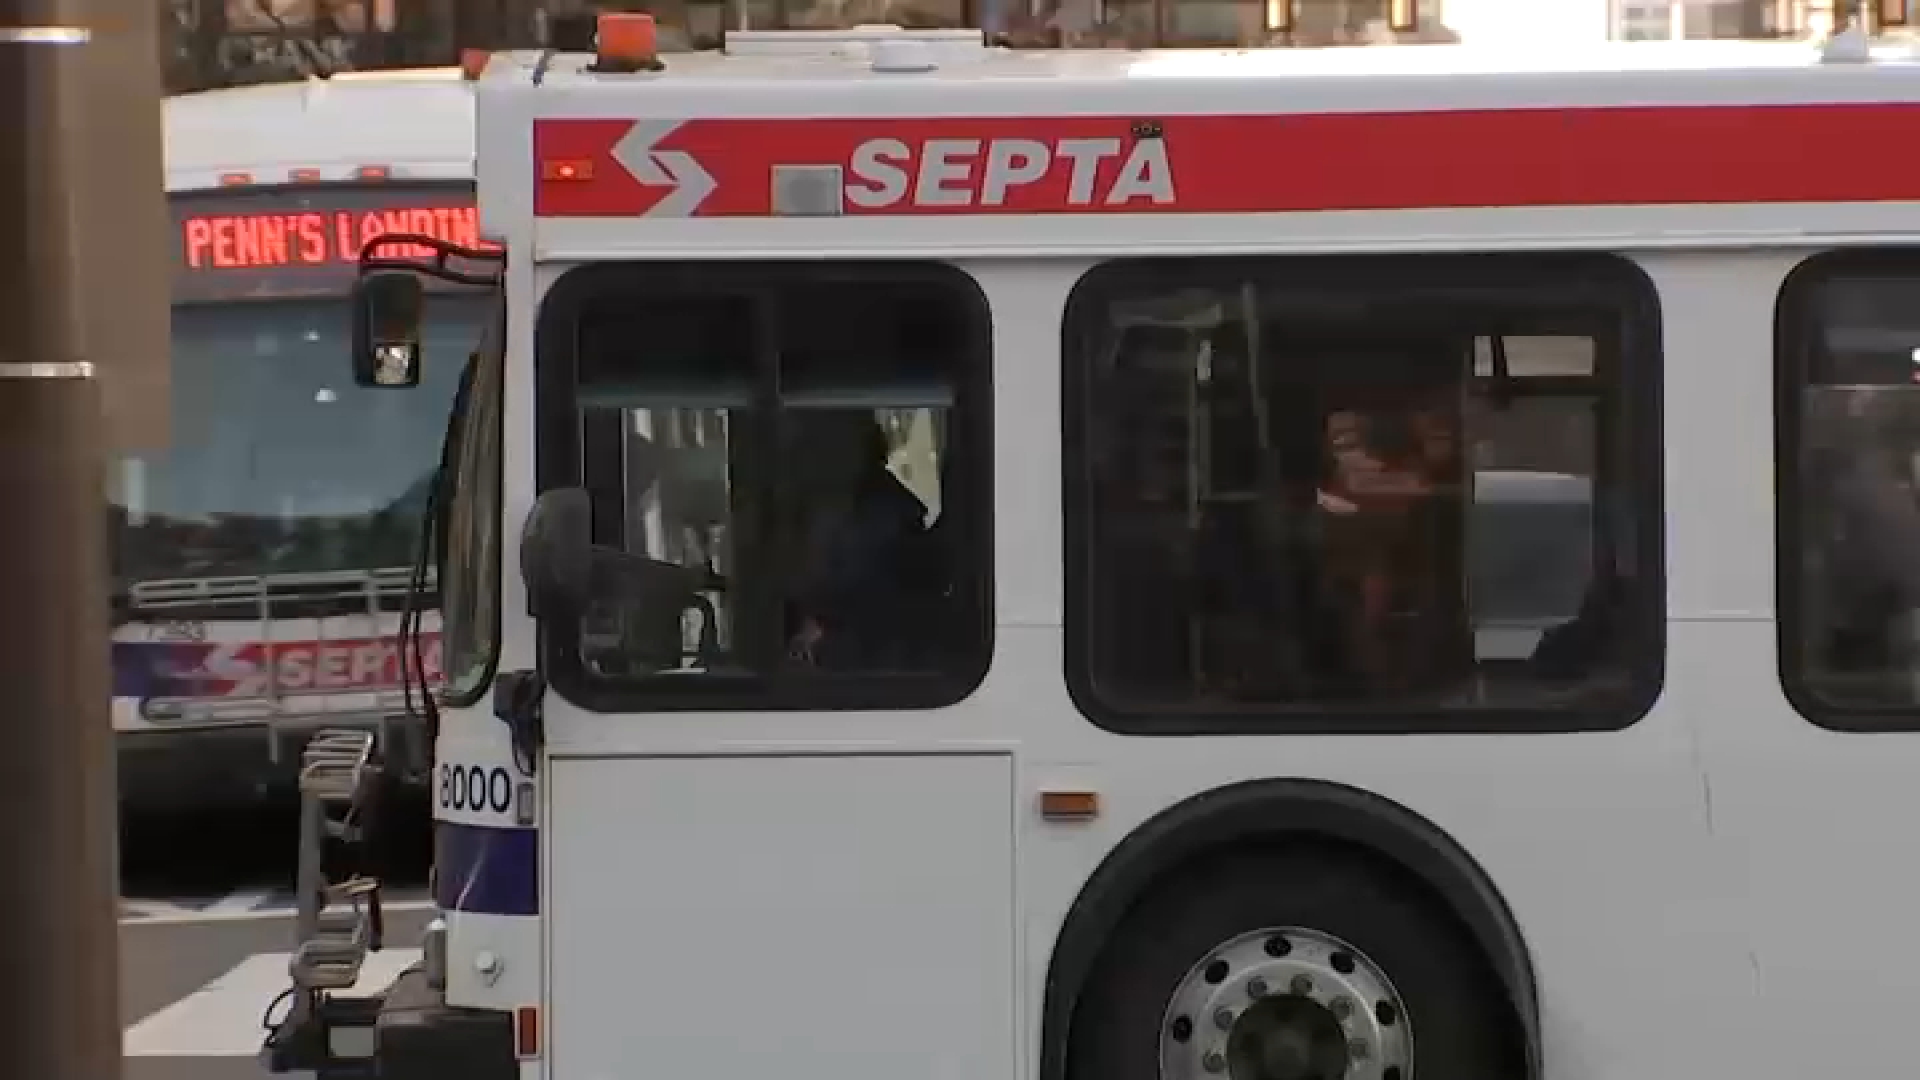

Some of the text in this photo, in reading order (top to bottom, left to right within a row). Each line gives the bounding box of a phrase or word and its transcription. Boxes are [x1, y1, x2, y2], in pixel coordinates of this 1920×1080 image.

[844, 136, 1176, 207] SEPTA
[185, 207, 502, 267] PENN'S LANDIN
[440, 763, 512, 813] 8000
